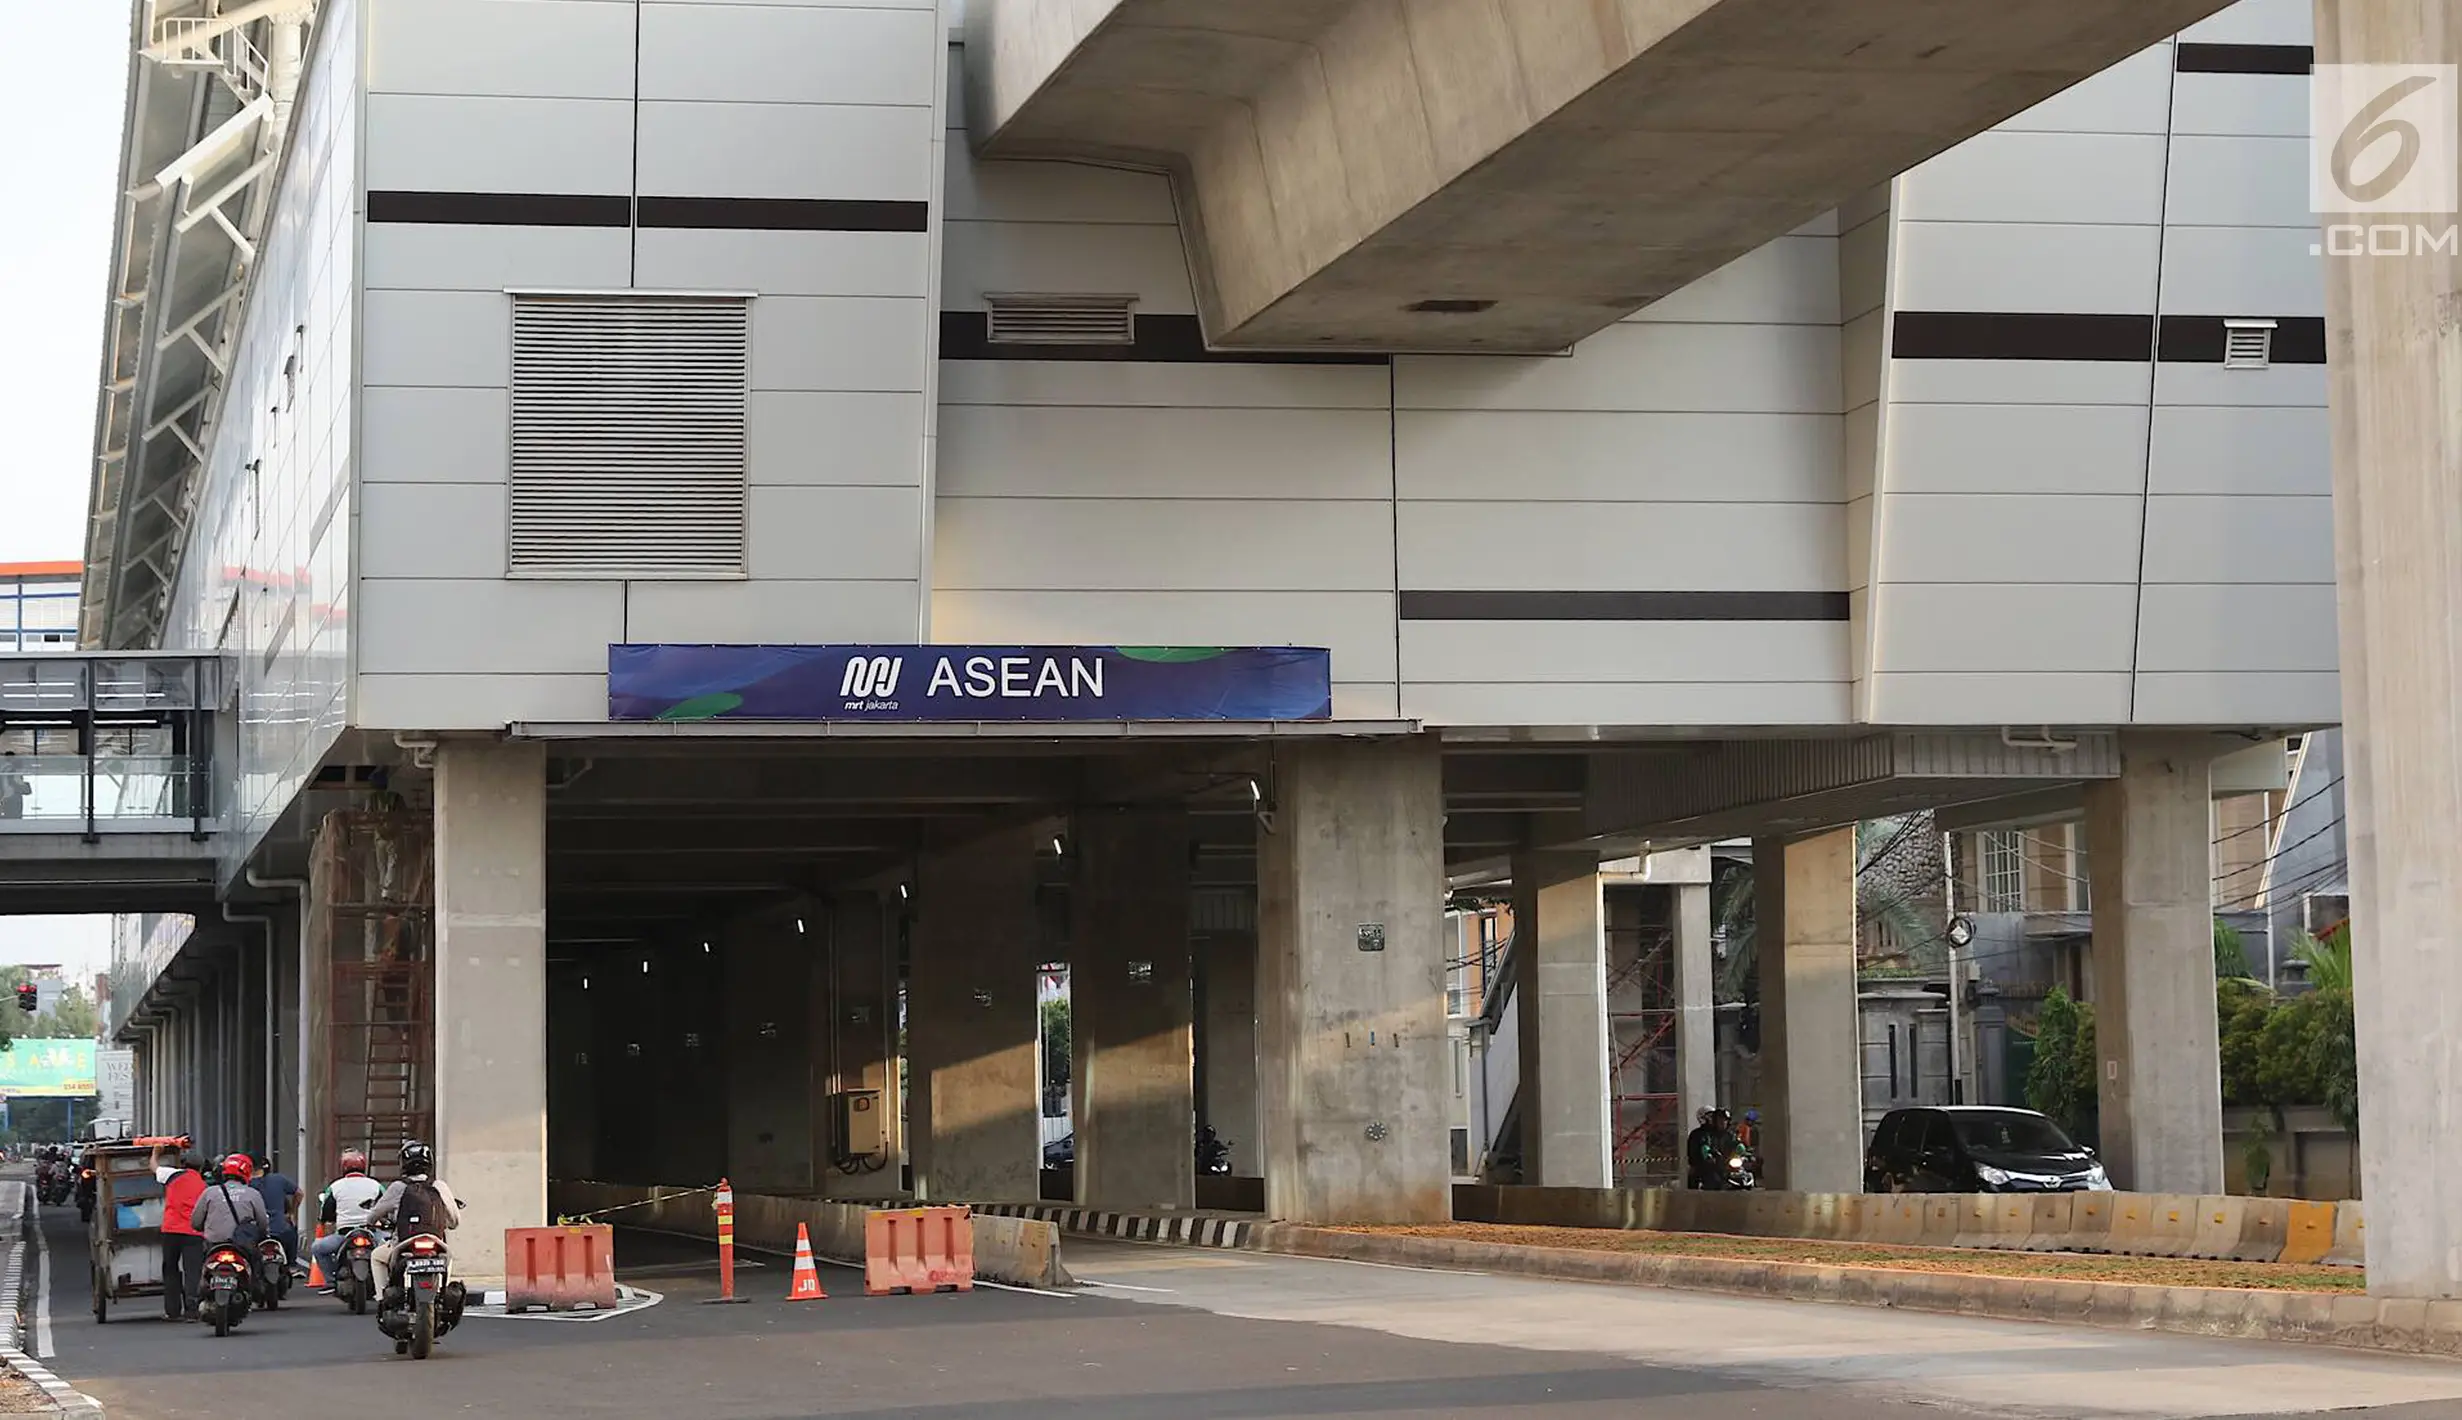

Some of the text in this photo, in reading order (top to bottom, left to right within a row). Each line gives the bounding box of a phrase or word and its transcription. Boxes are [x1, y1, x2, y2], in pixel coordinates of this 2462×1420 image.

[926, 656, 1103, 698] ASEAN
[844, 700, 899, 712] mrt jakarta
